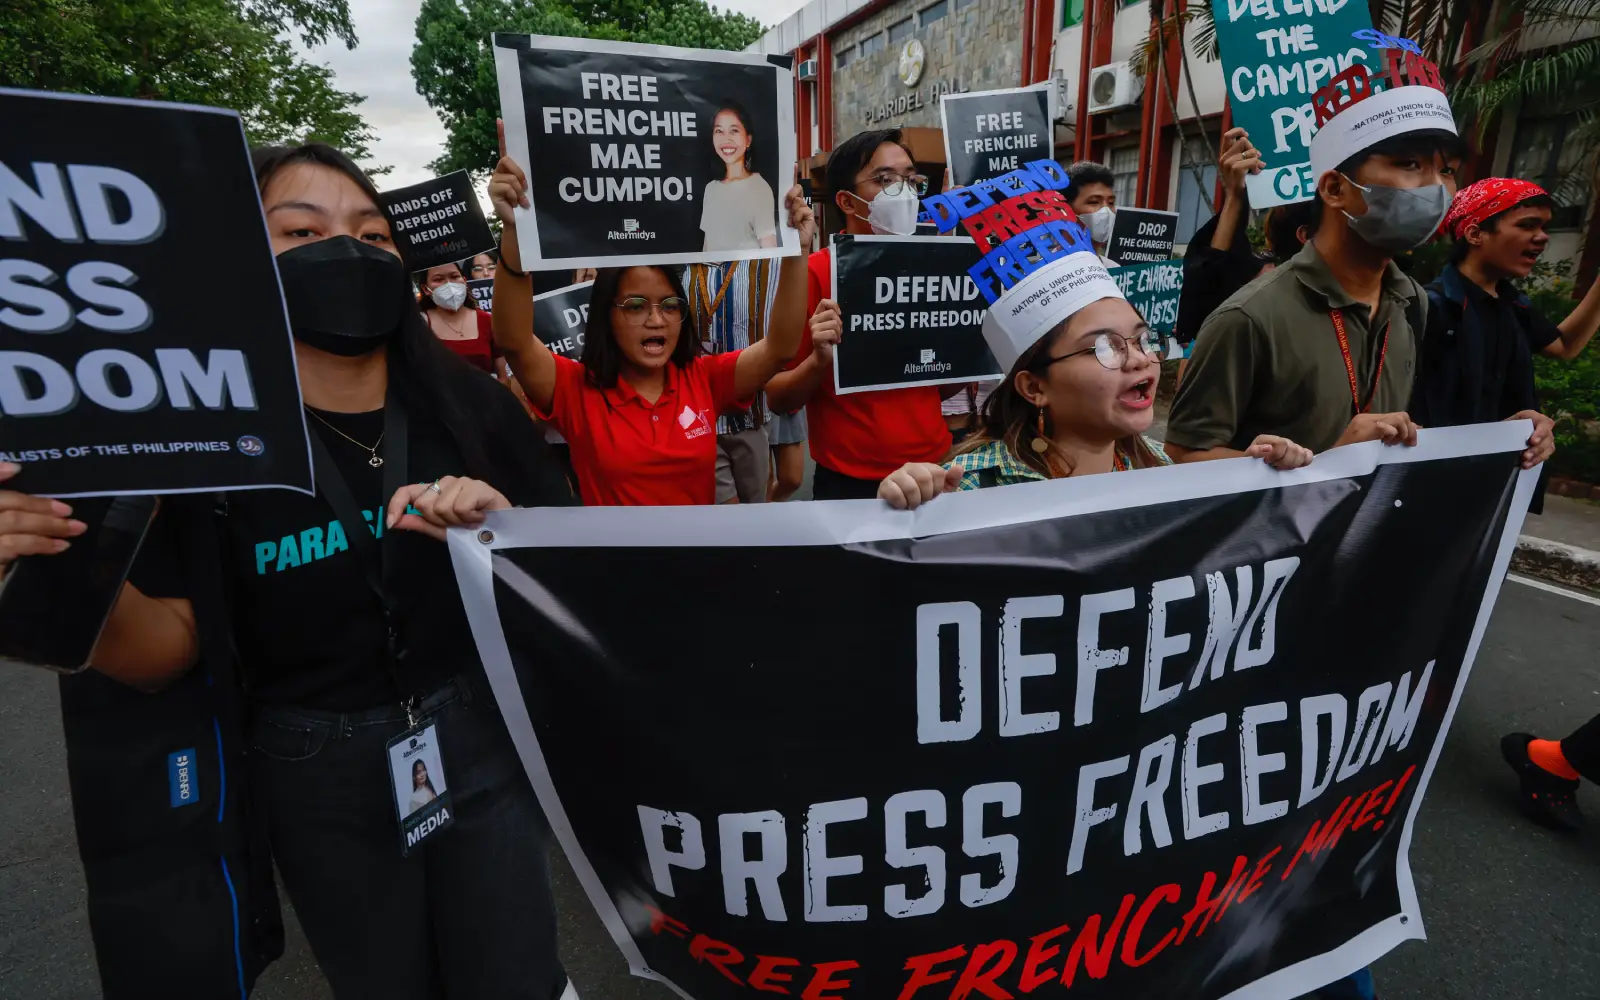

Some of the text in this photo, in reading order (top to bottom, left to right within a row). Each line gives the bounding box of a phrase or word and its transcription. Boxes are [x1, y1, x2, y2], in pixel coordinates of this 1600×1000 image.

[1256, 24, 1319, 57] THE
[580, 72, 659, 102] FREE
[864, 78, 969, 126] PLARIDEL HALL
[1397, 102, 1424, 112] UNION
[542, 106, 698, 137] FRENCHIE
[975, 111, 1024, 133] FREE
[1382, 117, 1394, 126] OF
[1396, 113, 1414, 121] THE
[590, 143, 662, 169] MAE
[964, 133, 1038, 154] FRENCHIE
[988, 155, 1019, 172] MAE
[431, 188, 453, 204] OFF
[558, 175, 694, 203] CUMPIO!
[921, 158, 1071, 234] DEFEND
[409, 223, 455, 245] MEDIA!
[961, 189, 1077, 255] PRESS
[1137, 221, 1167, 237] DROP
[1119, 237, 1136, 247] THE
[1136, 238, 1166, 250] CHARGES
[875, 276, 979, 303] DEFEND
[1048, 272, 1075, 289] UNION
[1075, 267, 1086, 276] OF
[1040, 297, 1052, 307] OF
[1052, 286, 1069, 299] THE
[850, 309, 987, 332] PRESS FREEDOM
[904, 361, 951, 374] Altermidya
[66, 446, 93, 458] OF
[93, 443, 129, 456] THE
[132, 441, 230, 454] PHILIPPINES
[255, 520, 348, 575] PARA
[916, 557, 1300, 744] DEFEND
[179, 768, 190, 799] BENRO
[637, 659, 1436, 922] PRESS FREEDOM
[407, 808, 450, 847] MEDIA
[644, 903, 860, 1000] FREE
[893, 846, 1282, 1000] FRENCHIE
